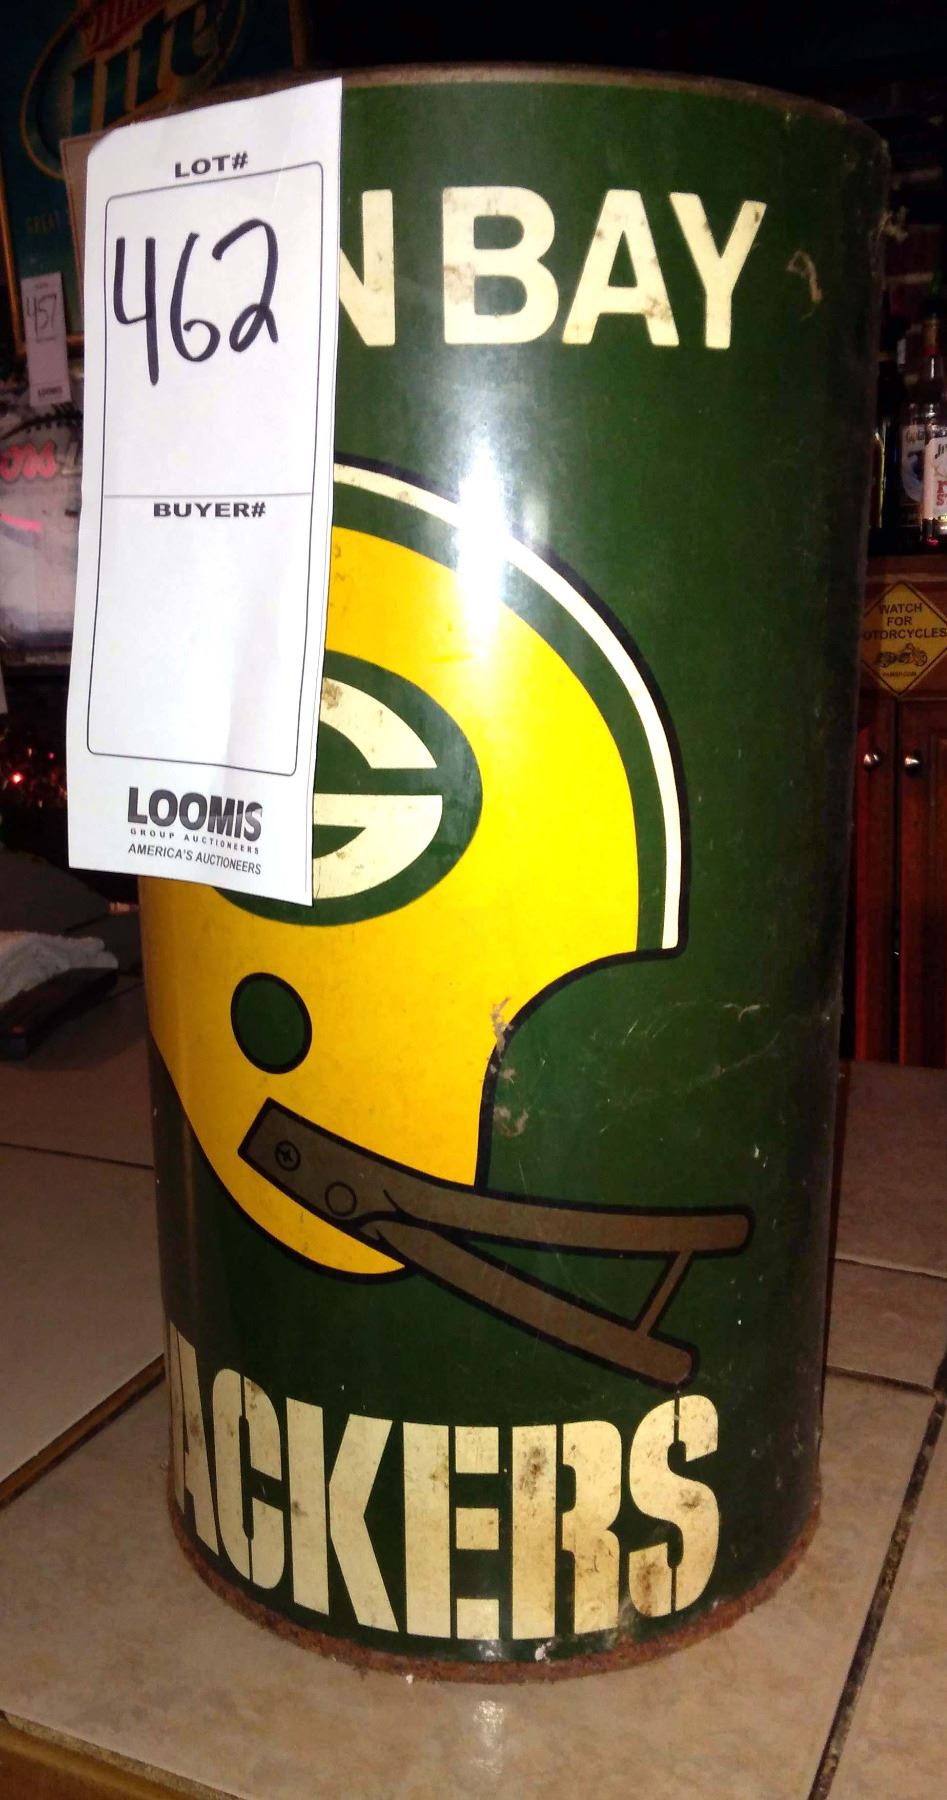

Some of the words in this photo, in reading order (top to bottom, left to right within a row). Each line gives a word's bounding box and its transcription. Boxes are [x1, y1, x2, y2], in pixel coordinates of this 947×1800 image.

[175, 152, 249, 178] LOT#
[442, 185, 768, 350] BAY
[26, 293, 57, 336] 457
[112, 218, 280, 387] 462
[153, 502, 267, 518] BUYER#
[879, 603, 922, 615] WATCH
[887, 615, 913, 627] FOR
[863, 627, 947, 641] OTORCYCLES
[127, 786, 263, 842] LOOMIS
[130, 827, 175, 840] GROUP
[184, 834, 259, 855] AUCTIONEERS
[128, 843, 193, 861] AMERICA'S
[195, 852, 262, 876] AUCTIONEERS
